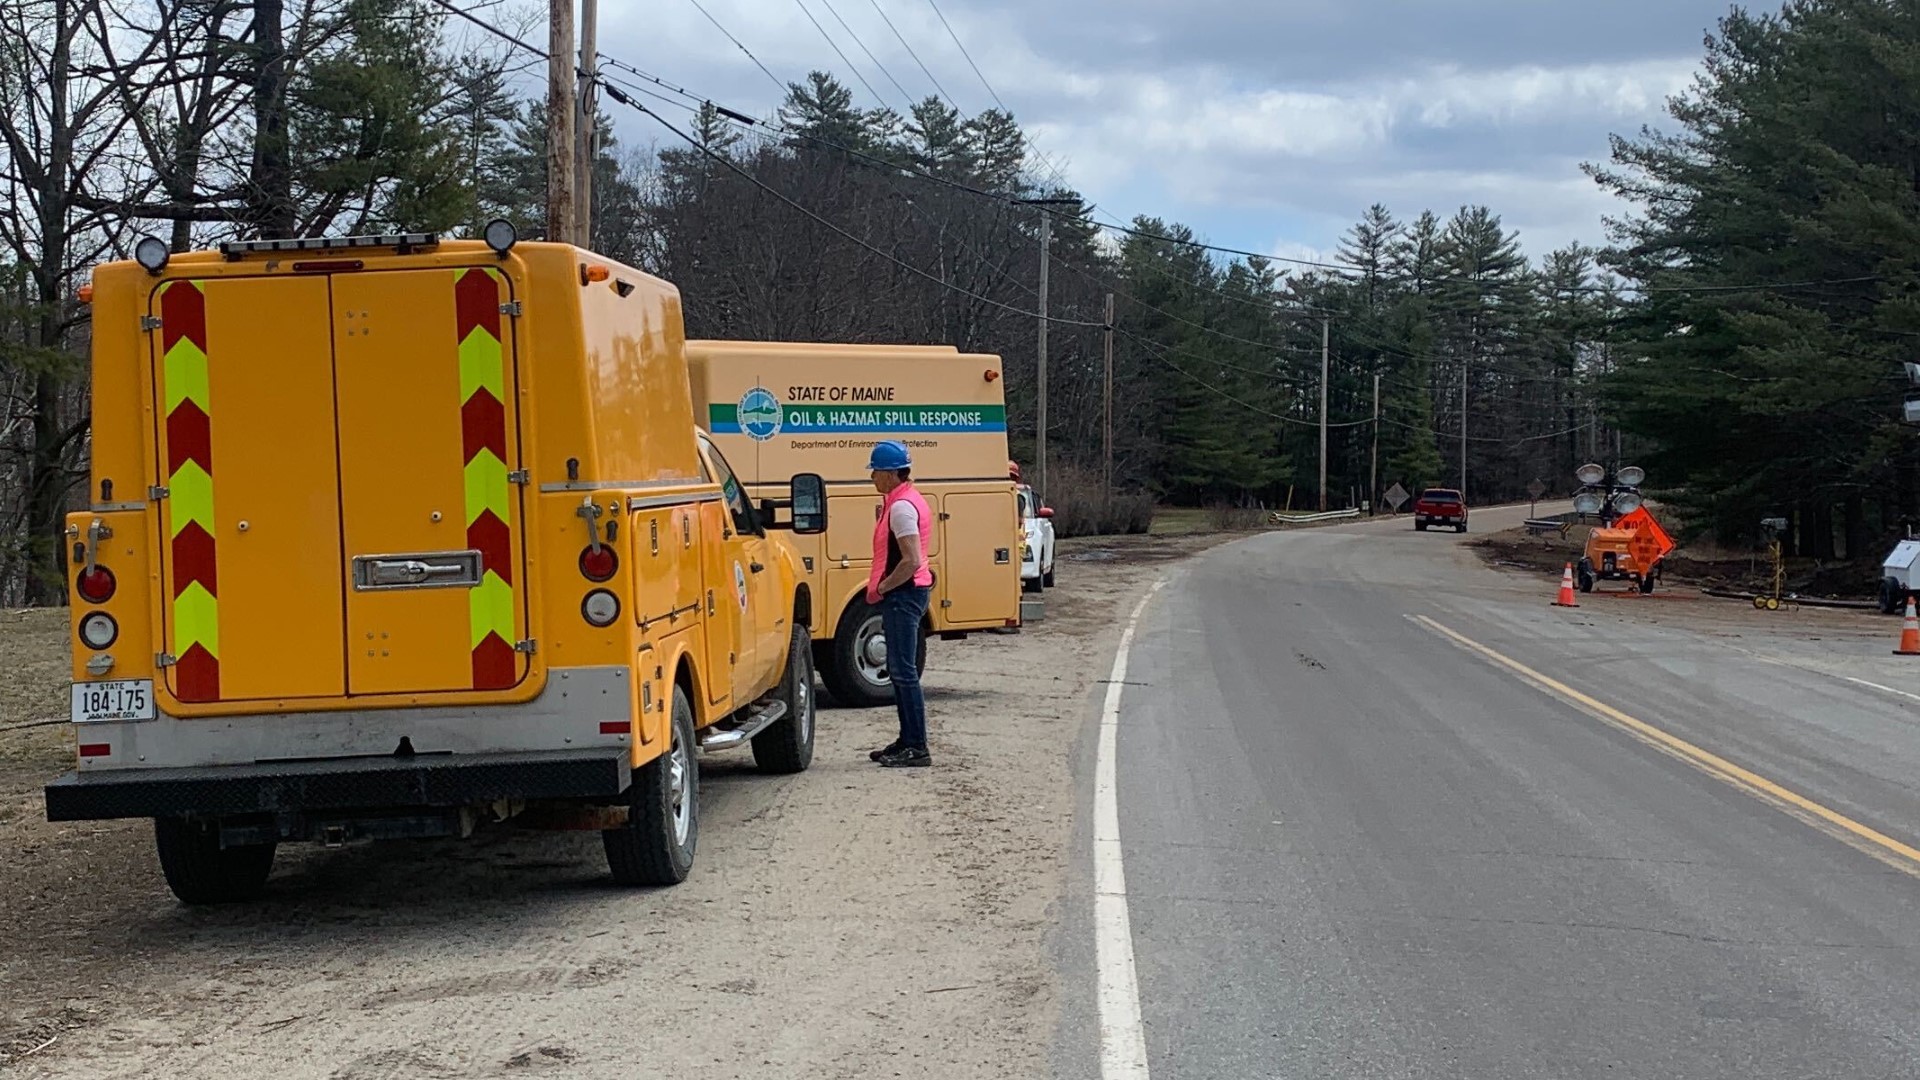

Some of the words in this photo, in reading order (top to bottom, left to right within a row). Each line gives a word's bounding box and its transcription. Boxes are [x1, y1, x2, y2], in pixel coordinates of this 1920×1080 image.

[788, 386, 826, 401] STATE
[829, 387, 848, 401] OF
[851, 387, 895, 401] MAINE
[789, 411, 813, 427] OIL
[816, 411, 827, 426] &
[830, 411, 881, 426] HAZMAT
[884, 411, 917, 426] SPILL
[919, 411, 982, 426] RESPONSE
[791, 440, 838, 450] Department
[839, 440, 849, 448] Of
